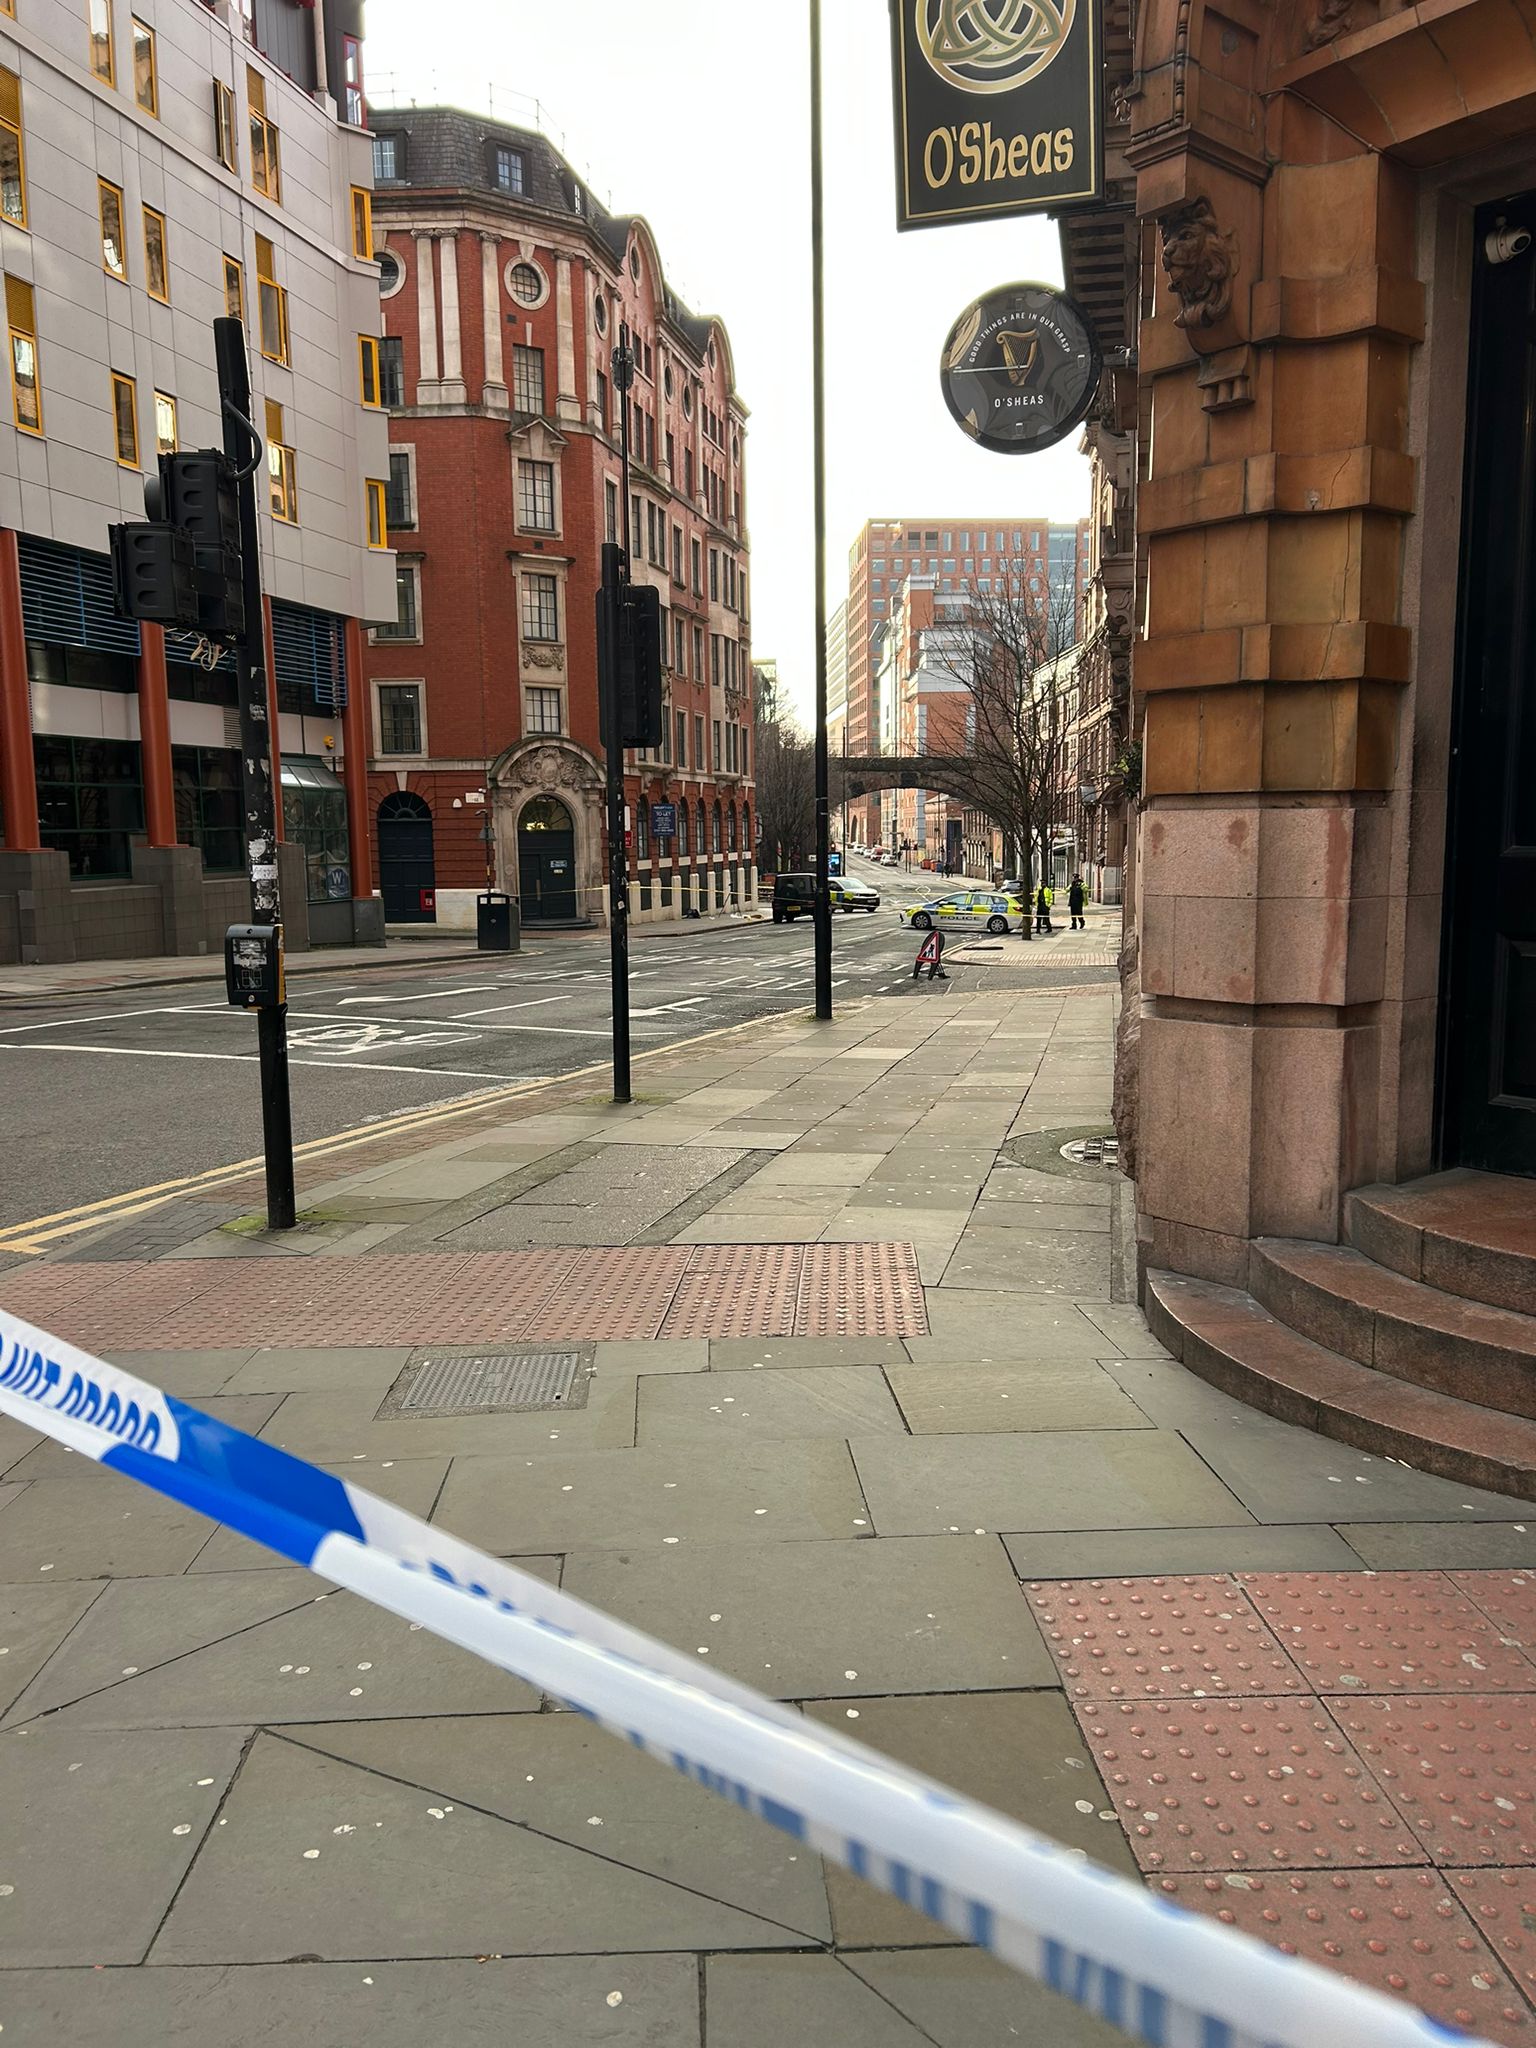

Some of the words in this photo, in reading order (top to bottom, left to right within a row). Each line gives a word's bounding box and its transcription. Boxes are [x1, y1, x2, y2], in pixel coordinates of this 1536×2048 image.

[924, 120, 1075, 189] O'Sheas
[968, 340, 983, 363] GOOD
[980, 317, 1008, 340] THINGS
[1010, 312, 1025, 321] ARE
[1028, 313, 1038, 321] IN
[1039, 315, 1055, 329] OUR
[1054, 326, 1071, 354] GRASP
[994, 394, 1045, 408] O'SHEAS
